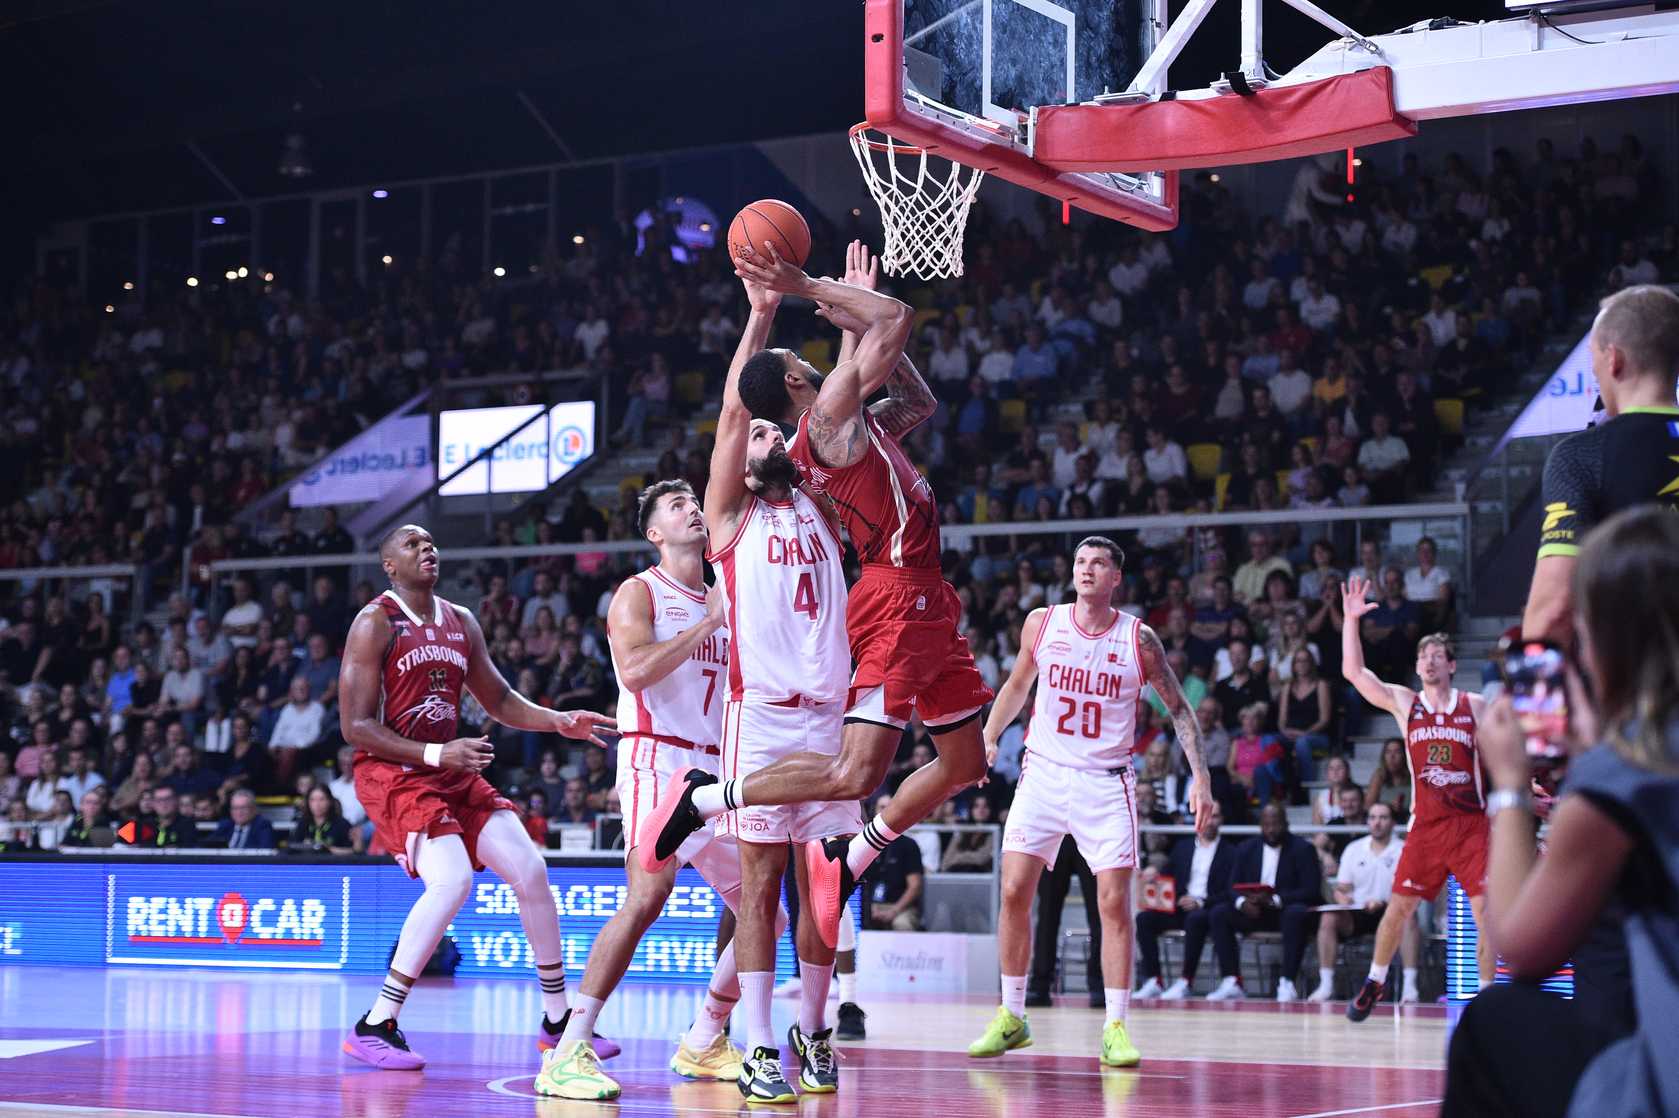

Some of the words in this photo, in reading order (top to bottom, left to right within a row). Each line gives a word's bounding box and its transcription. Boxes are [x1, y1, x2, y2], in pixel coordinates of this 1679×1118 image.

[793, 572, 819, 621] 4
[702, 668, 718, 717] 7
[1049, 663, 1123, 700] CHALON
[1056, 696, 1103, 740] 20
[1427, 744, 1452, 765] 23
[127, 896, 215, 937] RENT
[250, 898, 326, 939] CAR
